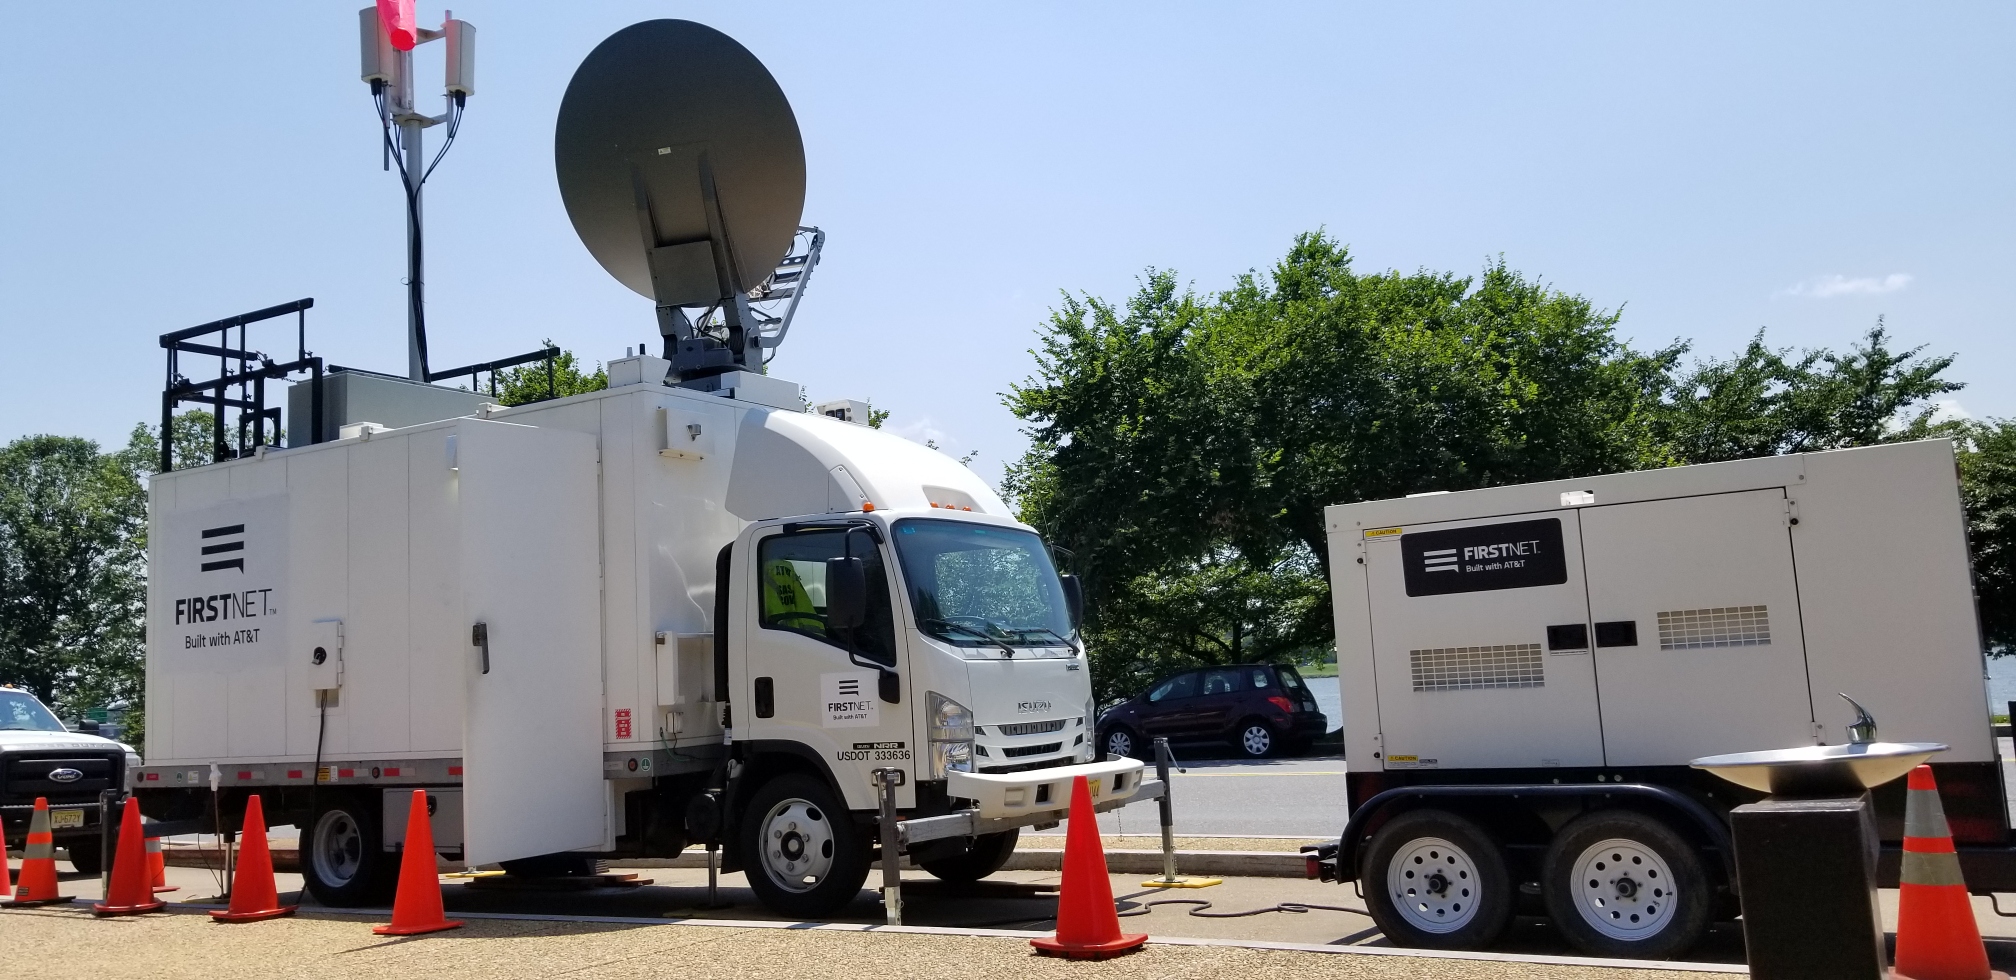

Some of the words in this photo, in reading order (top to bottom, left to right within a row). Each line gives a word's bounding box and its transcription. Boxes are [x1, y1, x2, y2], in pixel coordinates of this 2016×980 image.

[1463, 540, 1540, 560] FIRSTNET
[1465, 564, 1484, 573] Built
[1485, 562, 1503, 571] with
[1504, 560, 1525, 569] AT&T
[175, 588, 273, 625] FIRSTNET
[185, 633, 207, 649] Built
[209, 631, 231, 647] with
[233, 628, 260, 645] AT&T
[828, 701, 872, 712] FIRSTNET
[1018, 701, 1051, 714] ISUZU
[837, 750, 871, 761] USDOT
[874, 750, 911, 760] 333636
